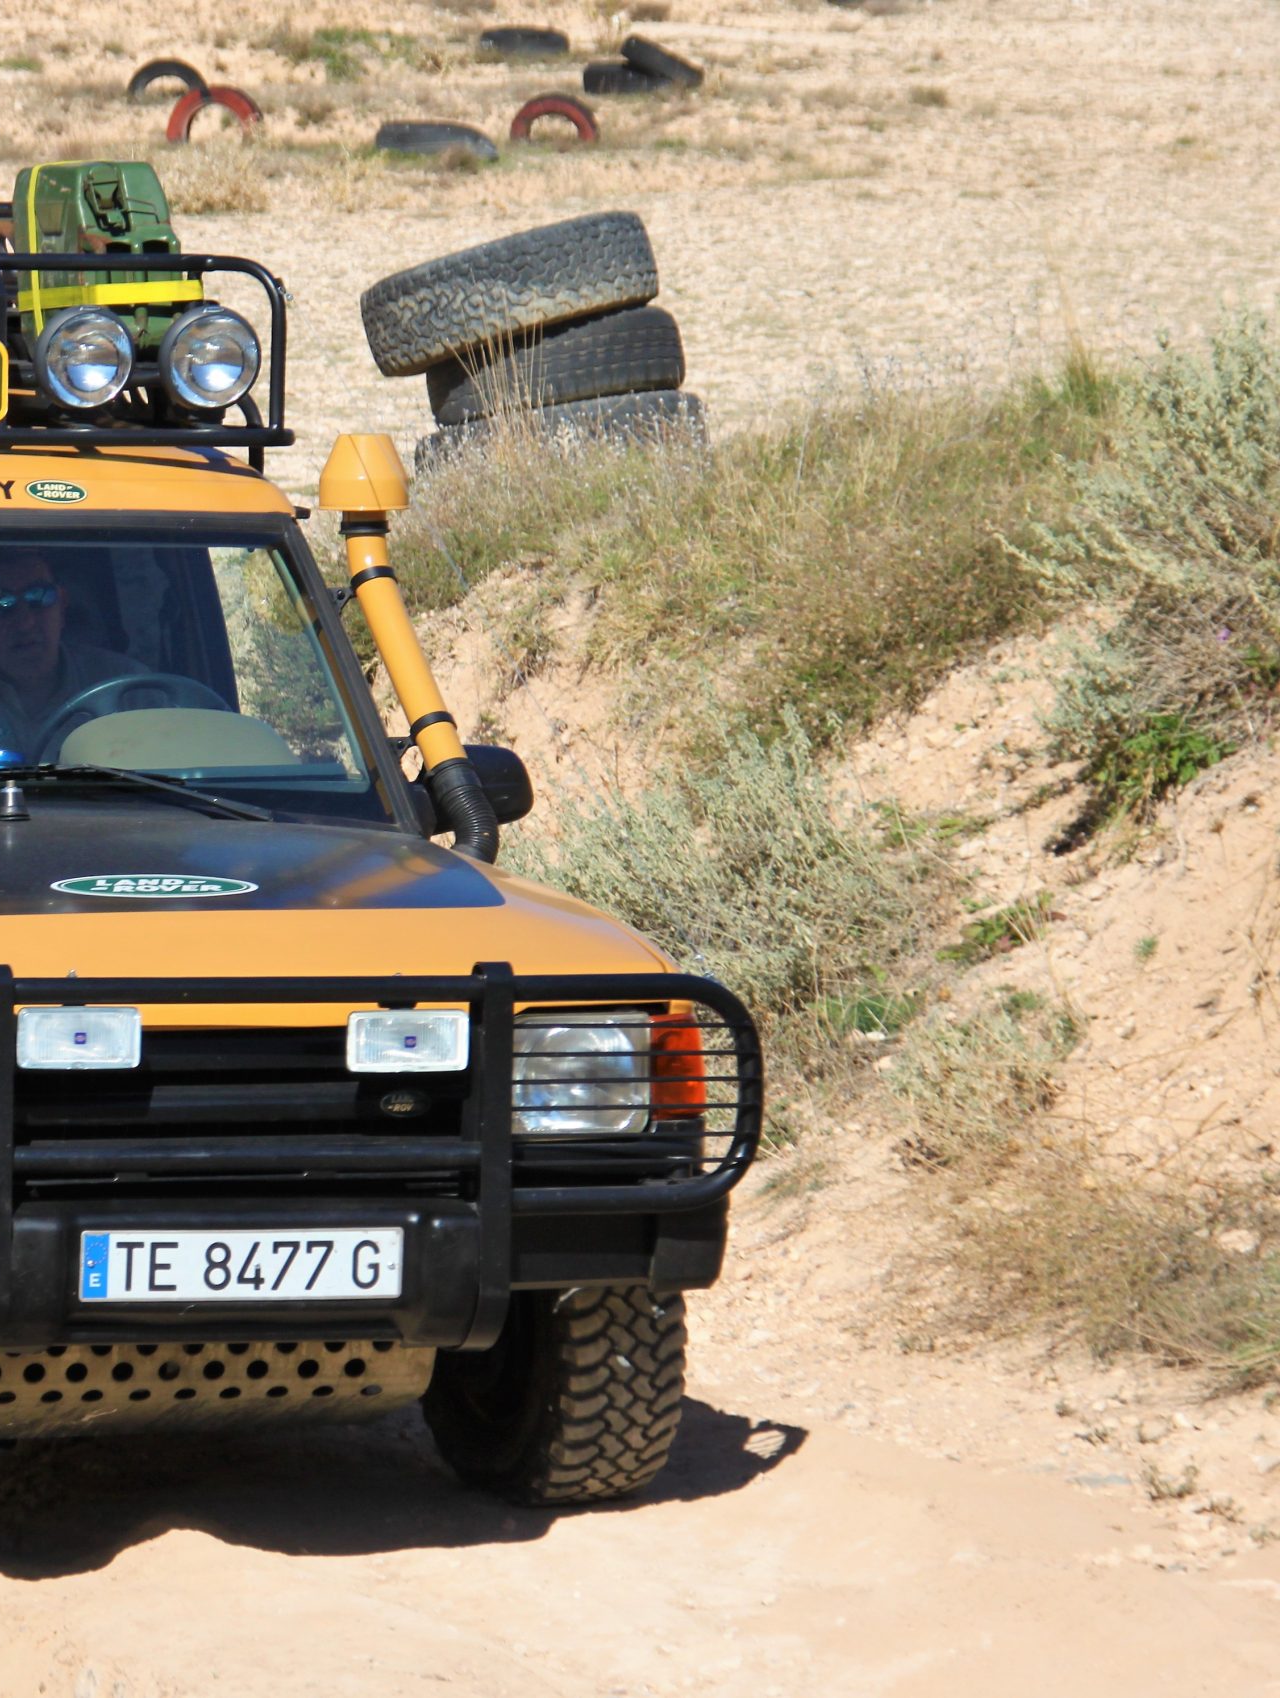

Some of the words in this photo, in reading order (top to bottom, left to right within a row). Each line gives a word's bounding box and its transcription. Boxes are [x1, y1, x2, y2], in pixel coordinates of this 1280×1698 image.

[89, 1273, 101, 1287] E
[116, 1241, 179, 1292] TE
[203, 1240, 334, 1292] 8477
[352, 1239, 381, 1290] G
